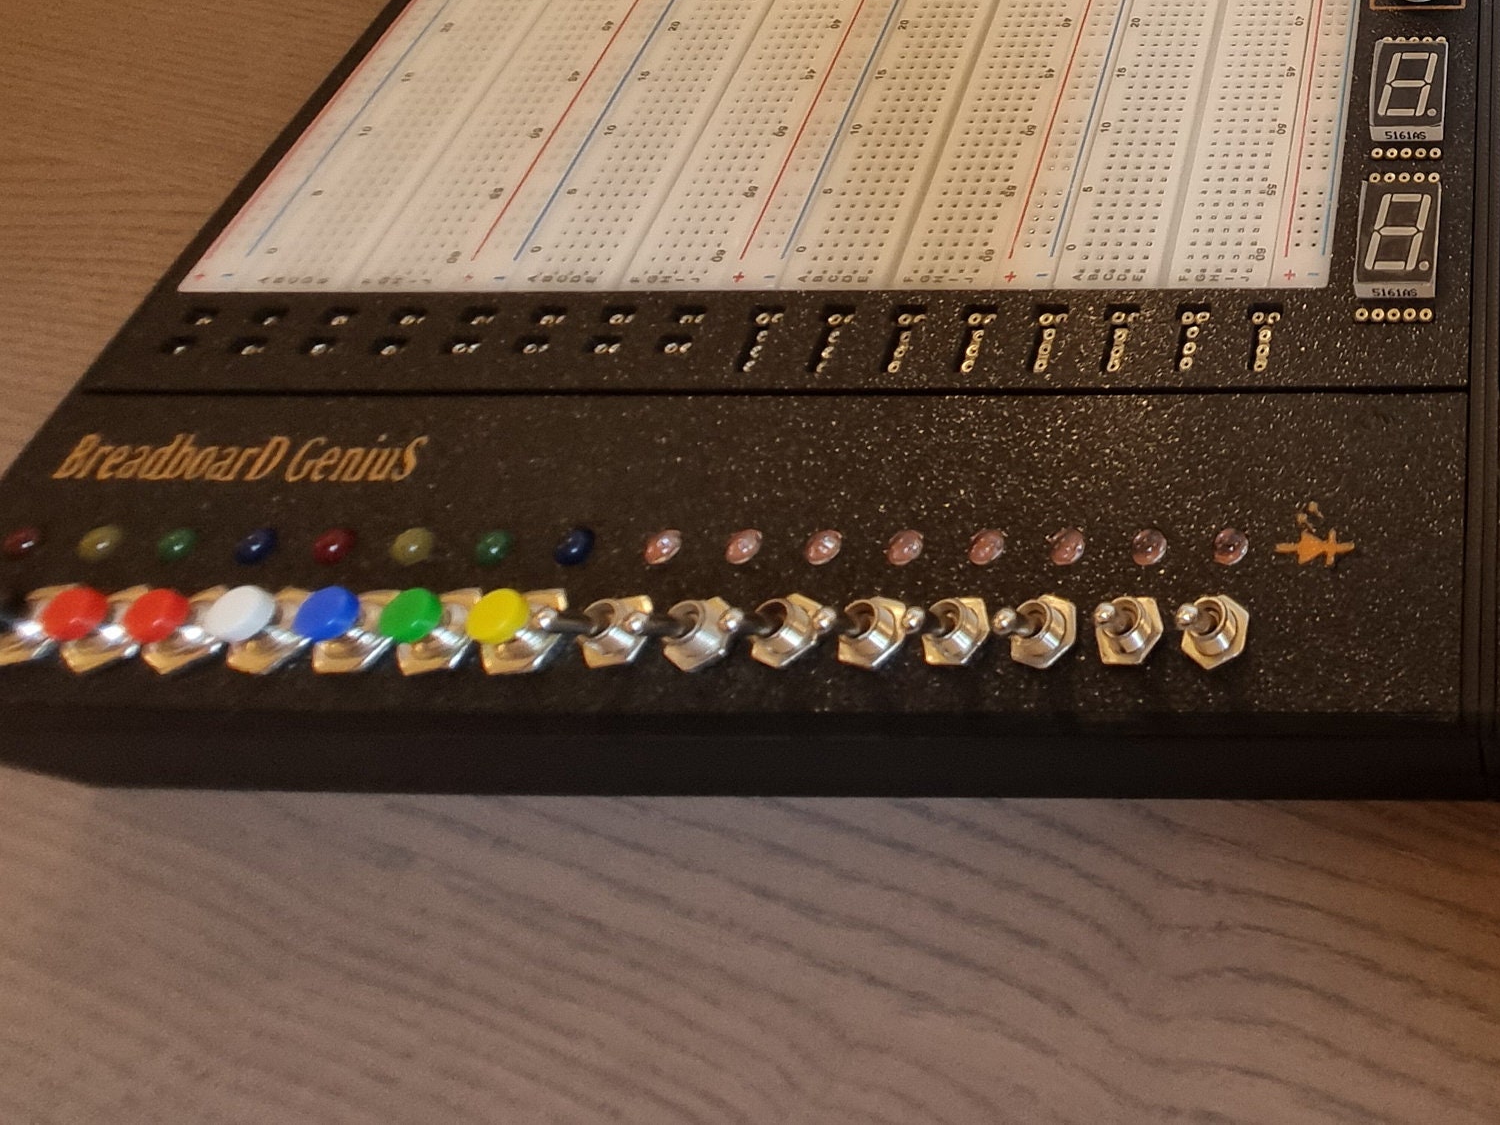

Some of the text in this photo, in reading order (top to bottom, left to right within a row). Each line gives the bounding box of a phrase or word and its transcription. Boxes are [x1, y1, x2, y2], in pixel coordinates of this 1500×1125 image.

[1384, 130, 1427, 141] 5161AS
[1372, 287, 1418, 298] 5161AS
[51, 432, 430, 483] BreadboarD GeniuS
